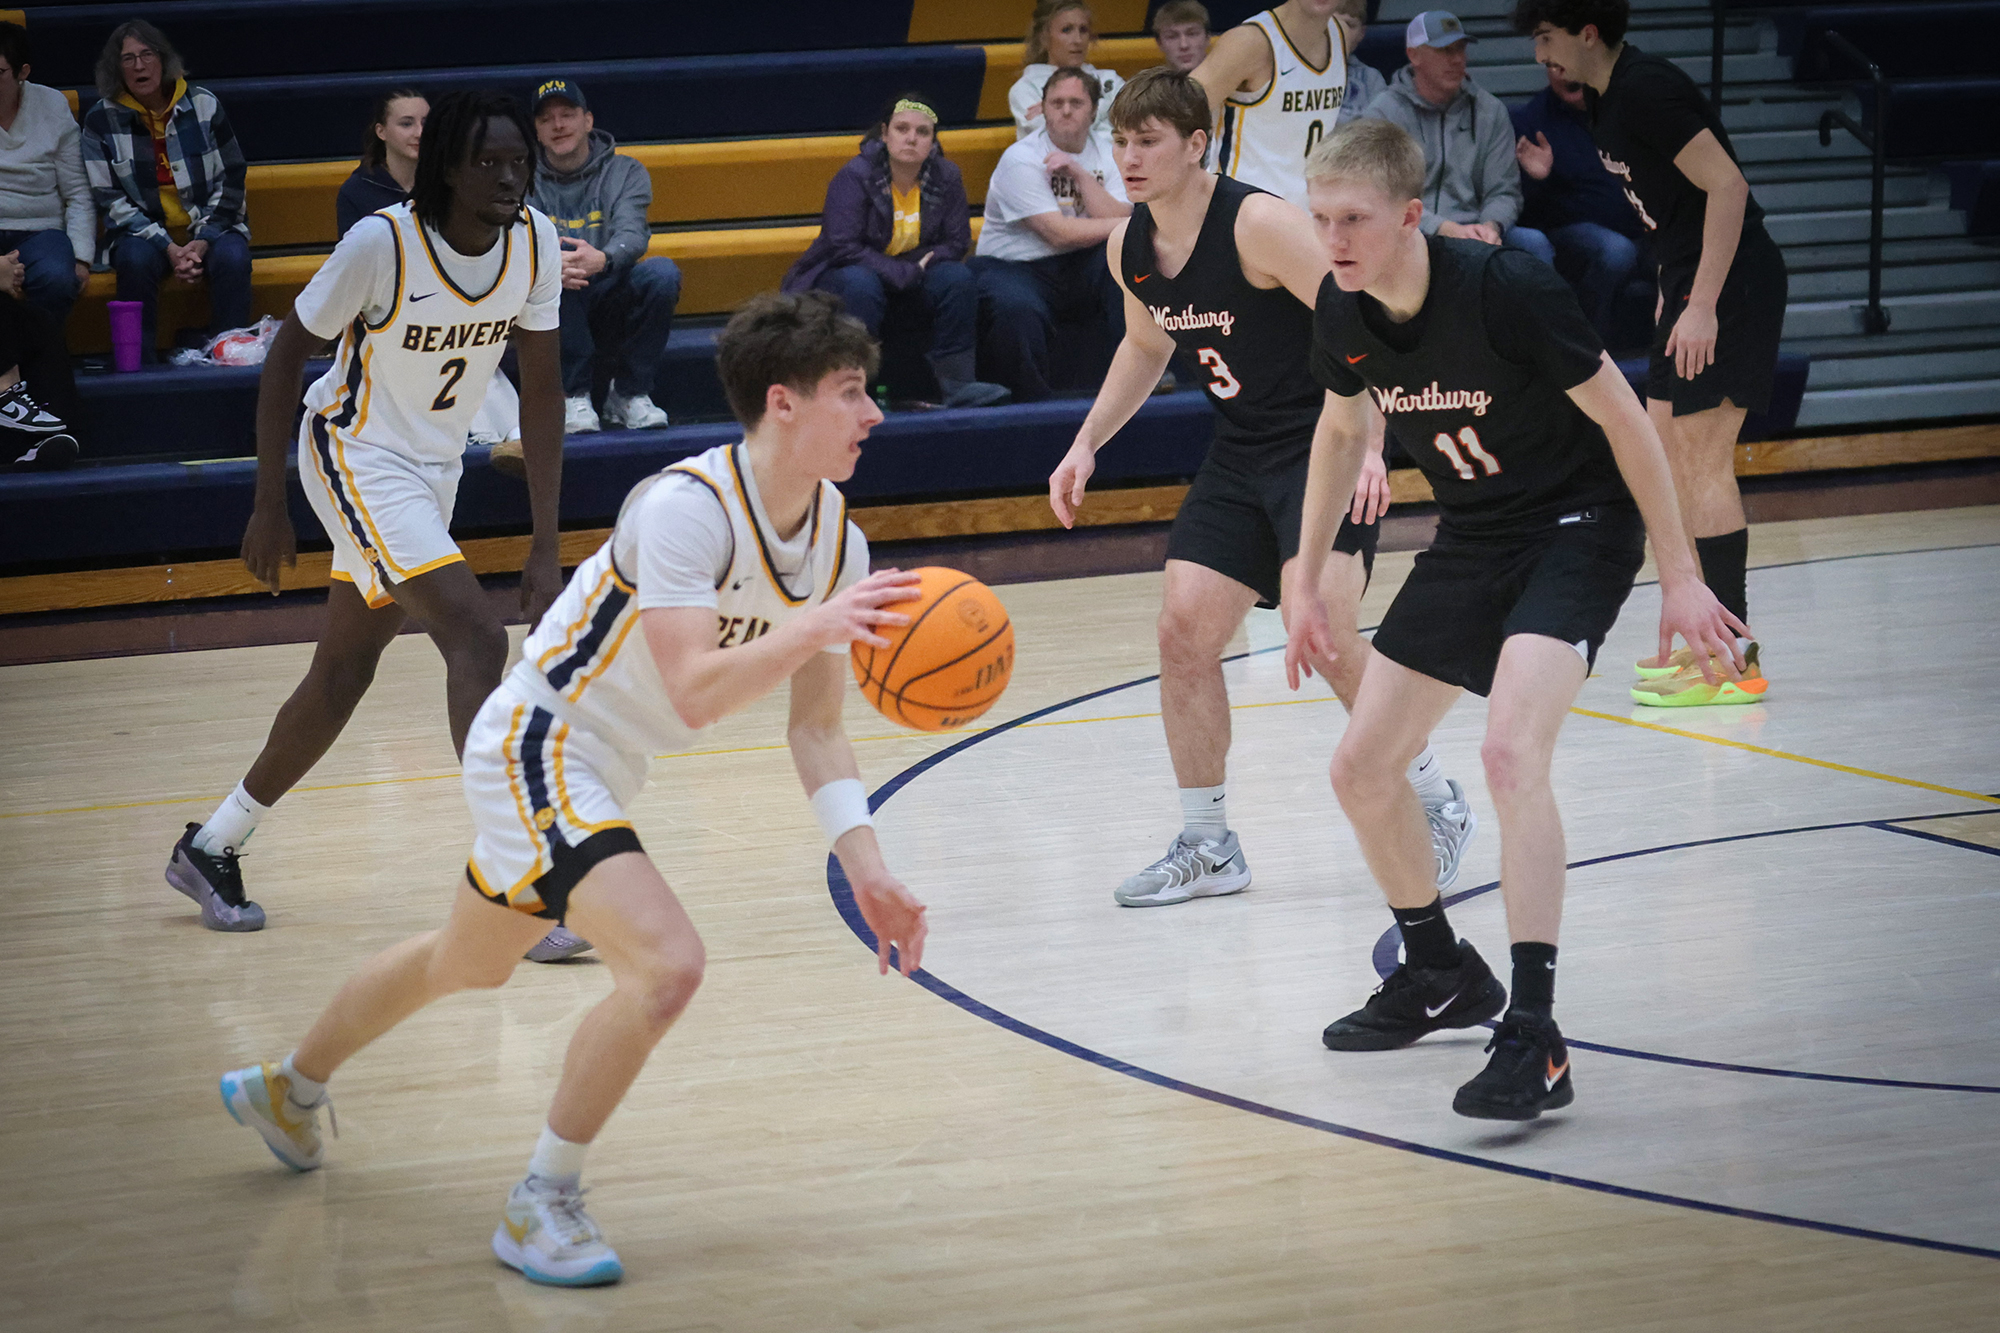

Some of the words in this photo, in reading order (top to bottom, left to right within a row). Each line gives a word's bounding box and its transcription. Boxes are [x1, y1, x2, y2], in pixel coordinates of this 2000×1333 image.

[1282, 86, 1344, 113] BEAVERS
[1148, 303, 1235, 336] Wartburg
[429, 356, 469, 412] 2
[1197, 346, 1242, 400] 3
[1372, 380, 1493, 417] Wartburg
[1433, 425, 1503, 480] 11
